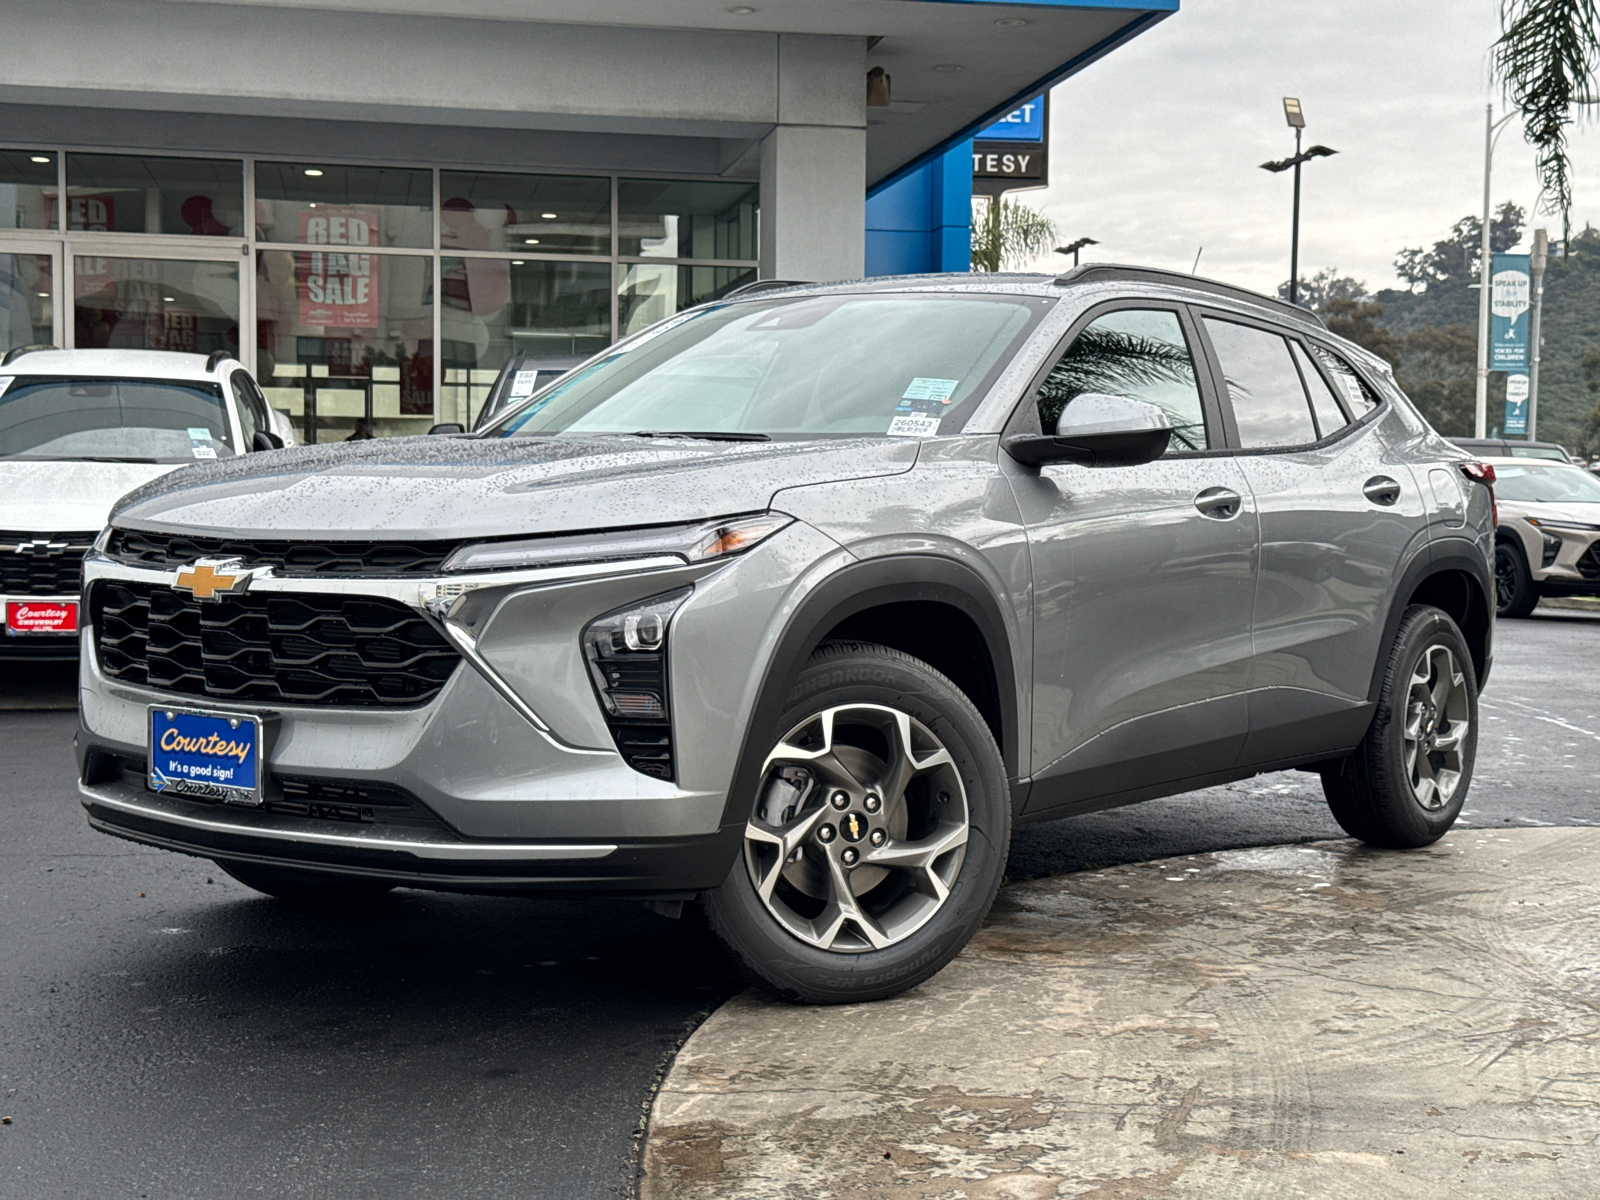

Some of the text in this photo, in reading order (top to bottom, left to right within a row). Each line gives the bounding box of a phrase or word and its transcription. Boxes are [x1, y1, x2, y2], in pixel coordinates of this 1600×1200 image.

[972, 154, 1030, 173] TESY
[307, 216, 369, 245] RED
[311, 252, 370, 276] TAG
[307, 275, 369, 305] SALE
[15, 606, 68, 619] Courtesy
[160, 728, 251, 764] Courtesy
[169, 761, 182, 772] It's
[190, 765, 211, 777] good
[213, 766, 234, 780] sign!
